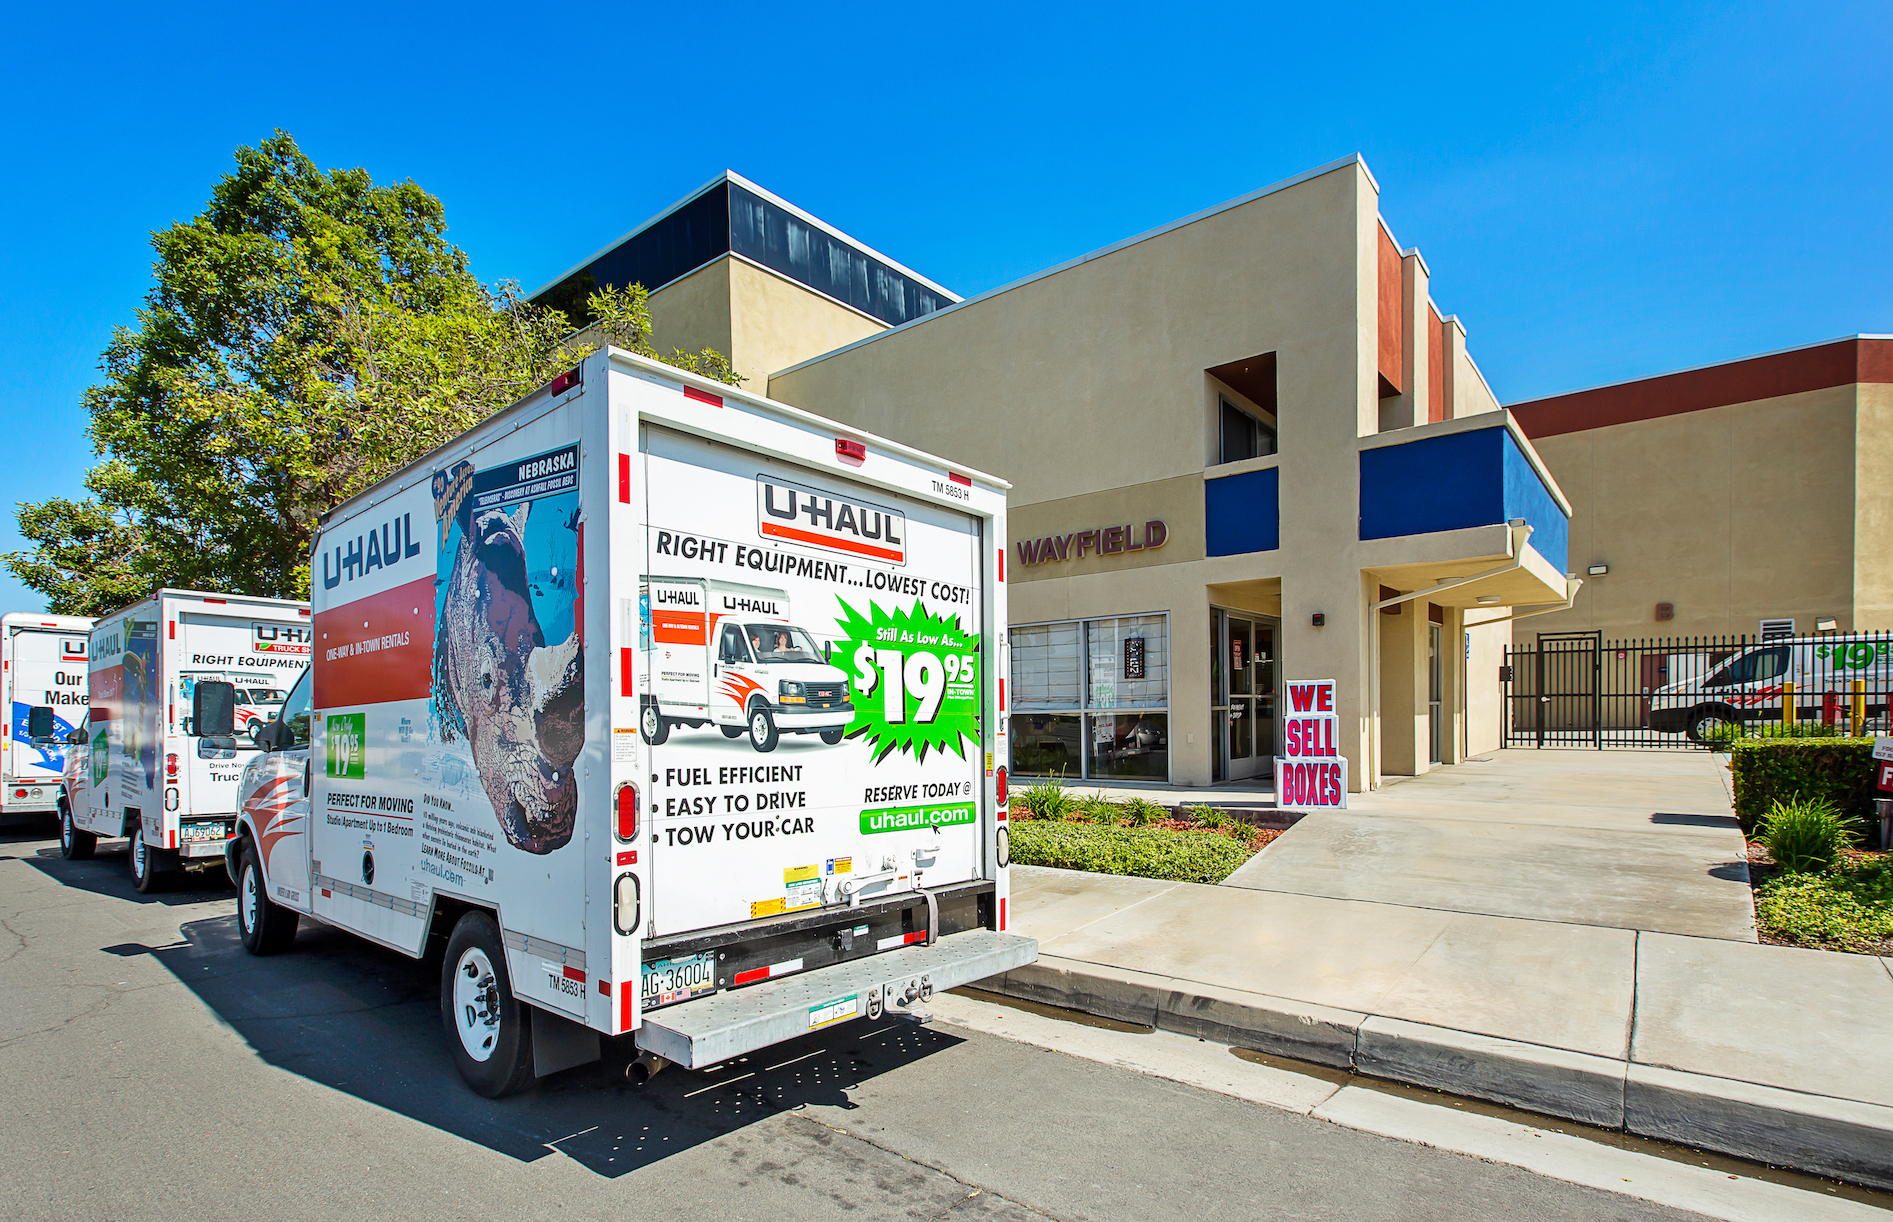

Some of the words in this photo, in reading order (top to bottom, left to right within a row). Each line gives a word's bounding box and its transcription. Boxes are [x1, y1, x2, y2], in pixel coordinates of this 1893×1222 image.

[518, 451, 574, 482] NEBRASKA
[525, 486, 530, 495] AT
[547, 478, 562, 490] FOSSIL
[562, 475, 574, 486] BEDS
[932, 480, 944, 494] TM
[945, 484, 962, 500] 5853
[964, 490, 970, 501] H
[765, 484, 900, 546] U-HAUL
[324, 512, 420, 590] U-HAUL
[1016, 520, 1170, 566] WAYFIELD
[656, 531, 728, 564] RIGHT
[866, 570, 926, 597] LOWEST
[931, 582, 970, 605] COST!
[657, 590, 700, 606] U-HAUL
[723, 596, 780, 615] U-HAUL
[1656, 602, 1674, 622] B
[92, 633, 122, 662] U-HAUL
[326, 645, 350, 662] ONE-WAY
[350, 643, 355, 657] &
[355, 637, 381, 655] IN-TOWN
[381, 631, 410, 650] RENTALS
[876, 627, 898, 641] Still
[900, 630, 914, 643] As
[916, 631, 939, 646] Low
[192, 654, 234, 665] RIGHT
[273, 645, 300, 653] TRUCK
[55, 671, 82, 686] Our
[235, 677, 270, 685] U-HAUL
[45, 690, 90, 705] Make
[947, 688, 975, 696] IN-TOWN
[1289, 684, 1332, 712] WE
[1287, 718, 1336, 757] SELL
[210, 772, 242, 782] Truc
[666, 768, 712, 787] FUEL
[719, 765, 803, 785] EFFICIENT
[1283, 763, 1341, 806] BOXES
[327, 792, 360, 808] PERFECT
[360, 795, 377, 810] FOR
[378, 796, 414, 814] MOVING
[864, 785, 918, 803] RESERVE
[922, 782, 961, 798] TODAY
[963, 781, 971, 795] @
[666, 796, 717, 817] EASY
[724, 794, 749, 812] TO
[756, 792, 806, 810] DRIVE
[368, 819, 376, 833] Up
[377, 820, 383, 832] to
[387, 821, 414, 837] Bedroom
[870, 807, 969, 830] uhaul.com
[184, 828, 221, 838] AJ69062
[665, 824, 716, 846] TOW
[722, 820, 775, 841] YOUR
[781, 817, 815, 836] CAR
[486, 842, 497, 854] What
[421, 858, 464, 887] uhaul.com
[549, 974, 560, 990] TM
[561, 978, 578, 997] 5853
[580, 985, 586, 1000] H
